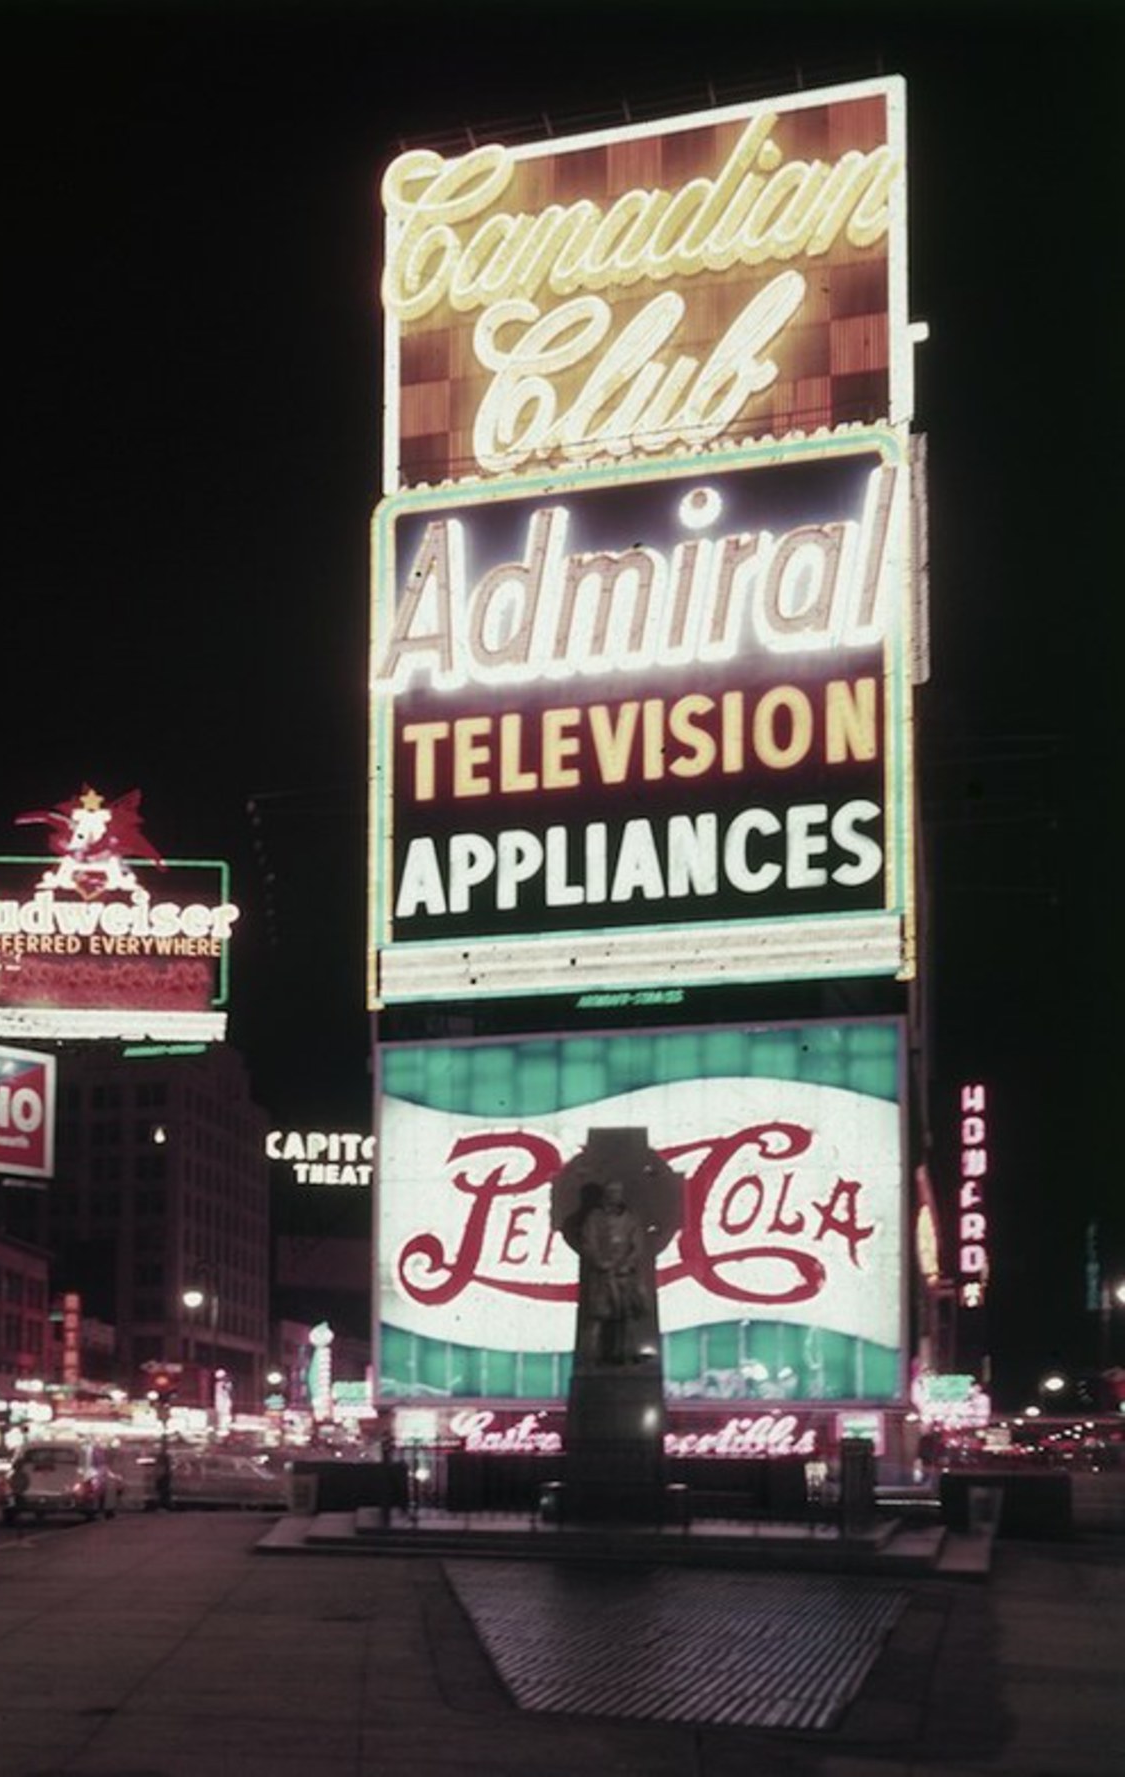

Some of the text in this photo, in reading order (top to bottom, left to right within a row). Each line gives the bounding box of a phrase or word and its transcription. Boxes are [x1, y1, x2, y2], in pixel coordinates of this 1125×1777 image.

[382, 110, 903, 320] Canadian
[473, 270, 806, 473] Club
[373, 465, 908, 694] Admiral
[403, 678, 876, 800] TELEVISION
[396, 800, 883, 918] APPLIANCES
[90, 936, 222, 957] EVERYWHERE
[265, 1131, 376, 1162] CAPITO
[293, 1163, 373, 1185] THEAT
